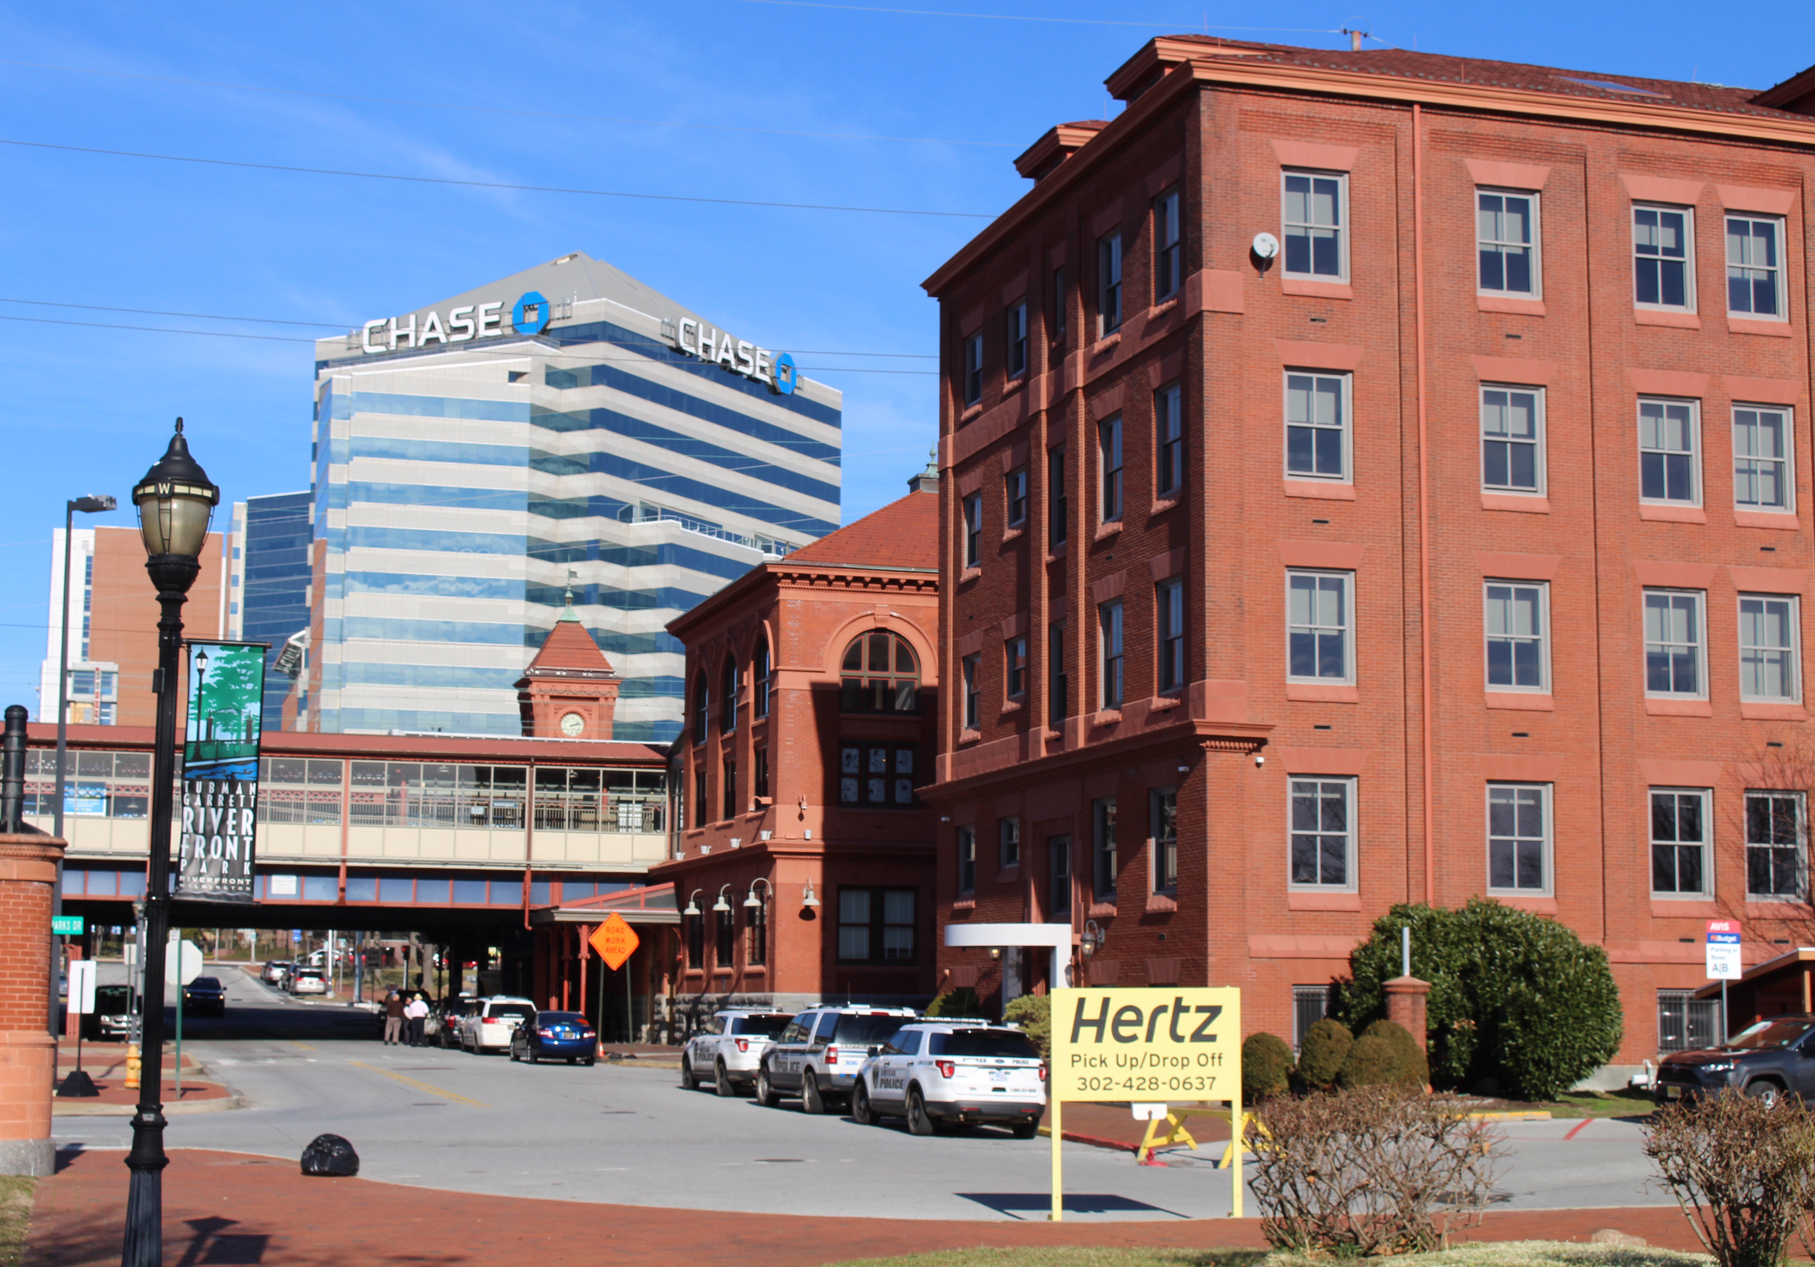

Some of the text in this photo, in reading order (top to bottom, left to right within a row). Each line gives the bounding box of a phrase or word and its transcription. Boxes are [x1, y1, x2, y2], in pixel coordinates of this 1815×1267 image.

[362, 301, 504, 354] CHASE
[678, 317, 772, 383] CHASE
[183, 781, 256, 795] TUBMAN
[183, 793, 256, 808] GARRETT
[182, 806, 254, 836] RIVER
[181, 834, 253, 861] FRONT
[180, 859, 251, 875] PARK
[179, 875, 252, 885] RIVERFRONT
[179, 882, 251, 892] WILMINGTON
[73, 920, 82, 931] DR
[605, 926, 625, 934] ROAD
[1710, 922, 1730, 931] AVIS
[605, 937, 626, 945] WORK
[1717, 935, 1737, 943] Budget
[605, 946, 626, 954] AHEAD
[1070, 997, 1223, 1043] Hertz
[1071, 1052, 1224, 1070] Pick Up/Drop Off
[880, 1078, 904, 1090] POLICE
[1077, 1076, 1217, 1091] 302-428-0637
